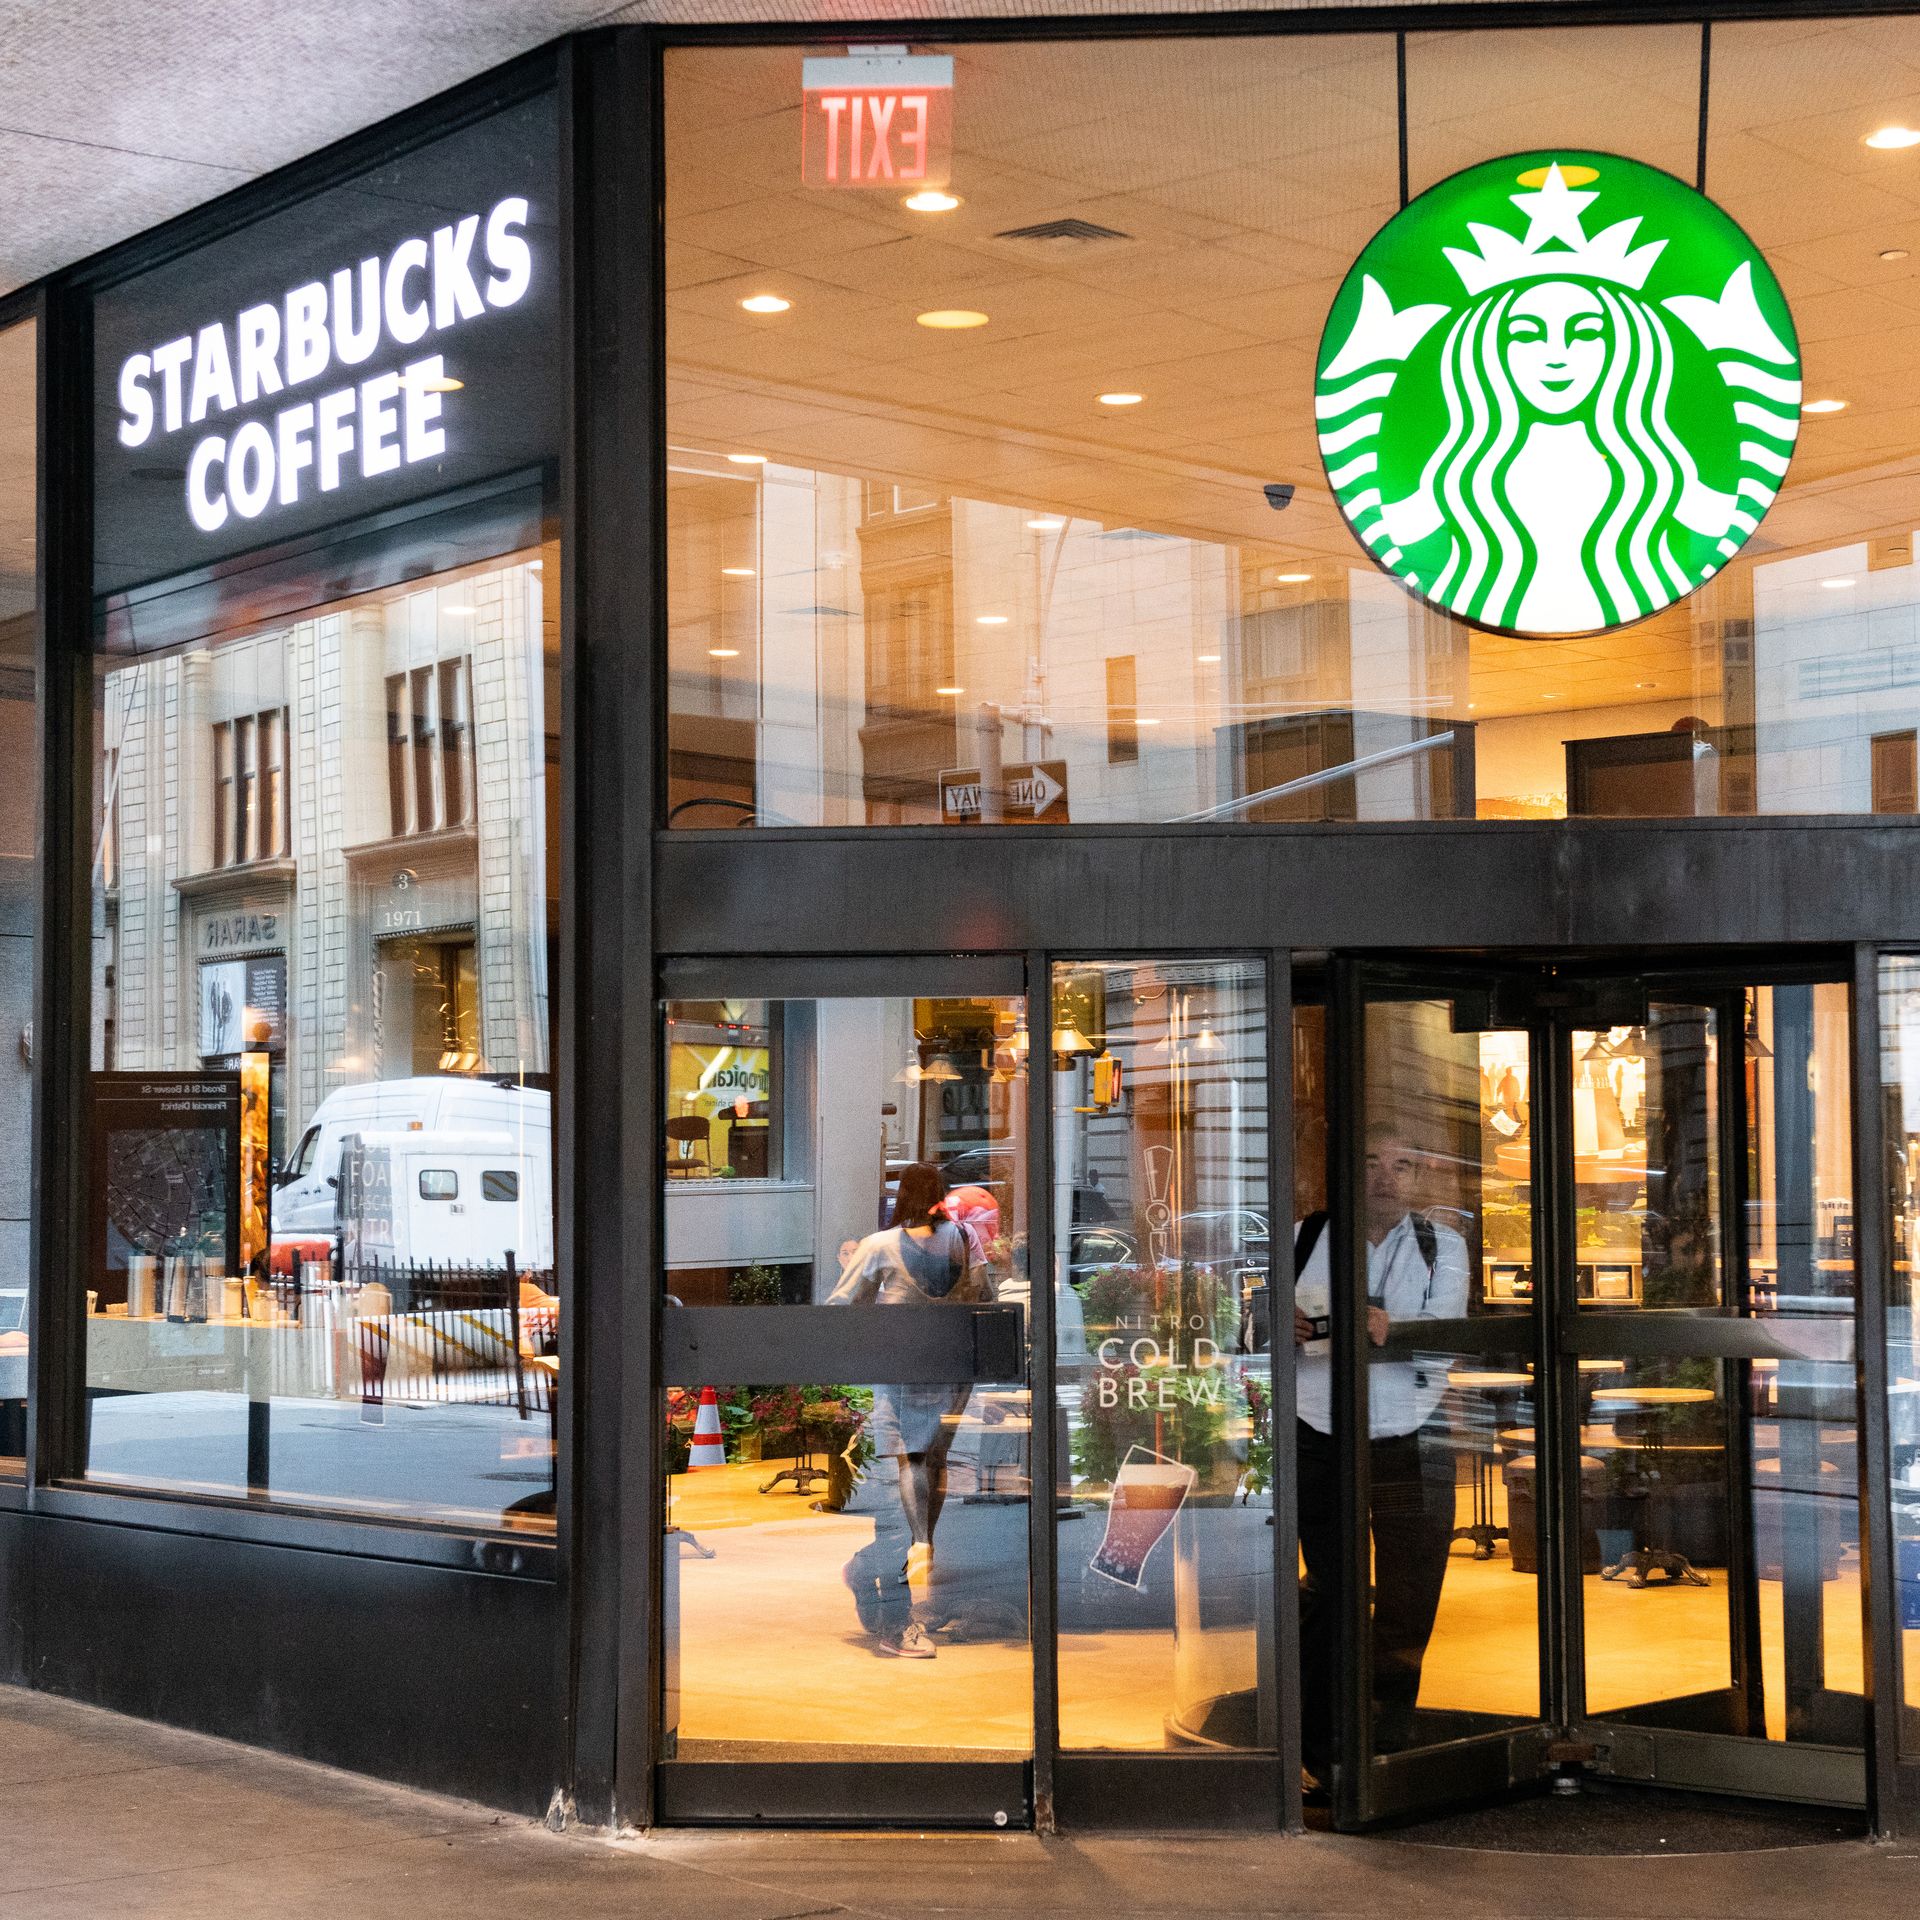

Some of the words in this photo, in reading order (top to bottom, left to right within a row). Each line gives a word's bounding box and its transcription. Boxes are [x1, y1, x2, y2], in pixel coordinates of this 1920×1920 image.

[118, 196, 532, 448] STARBUCKS
[186, 354, 446, 532] COFFEE
[398, 873, 409, 890] 3
[384, 910, 422, 927] 1971
[1115, 1314, 1205, 1331] NITRO
[1097, 1337, 1221, 1370] COLD
[1098, 1376, 1222, 1409] BREW
